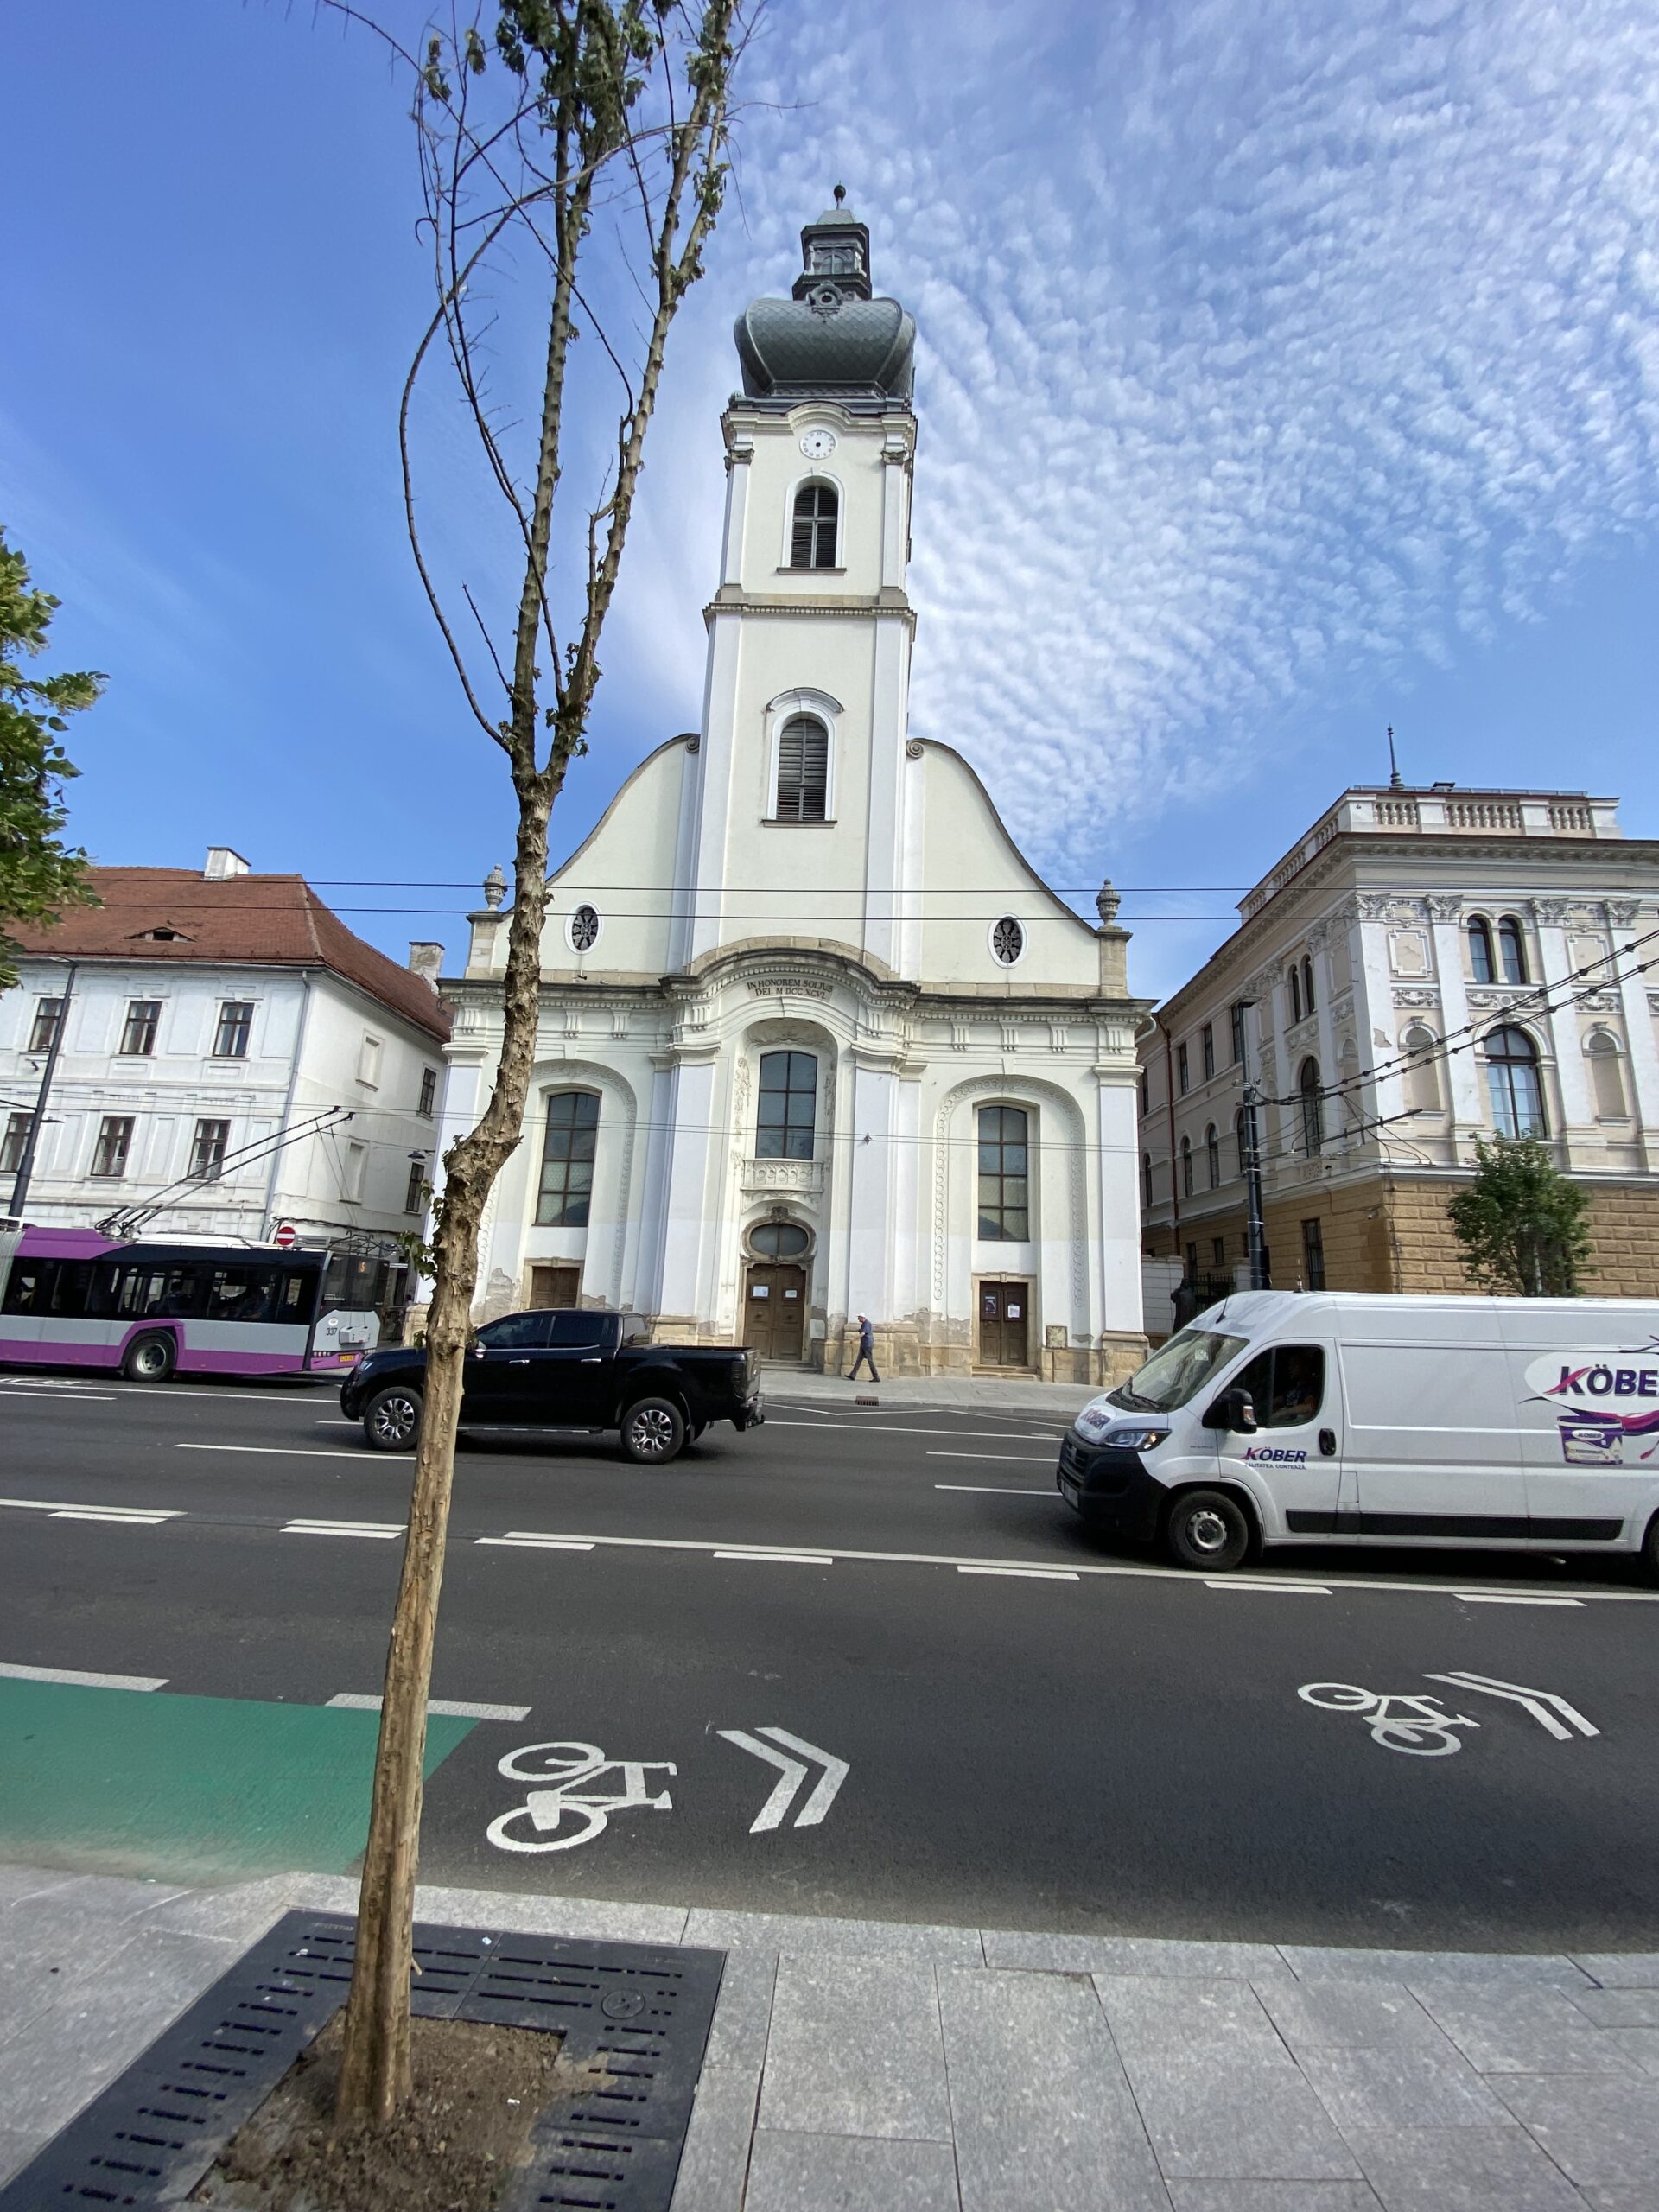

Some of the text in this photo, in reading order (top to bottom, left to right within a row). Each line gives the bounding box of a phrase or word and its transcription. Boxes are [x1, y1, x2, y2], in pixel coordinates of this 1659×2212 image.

[747, 982, 757, 990] IN
[758, 979, 801, 988] HONOREM
[326, 1327, 338, 1336] 337
[1545, 1364, 1659, 1396] KÖBE
[1240, 1446, 1307, 1463] KÖBER
